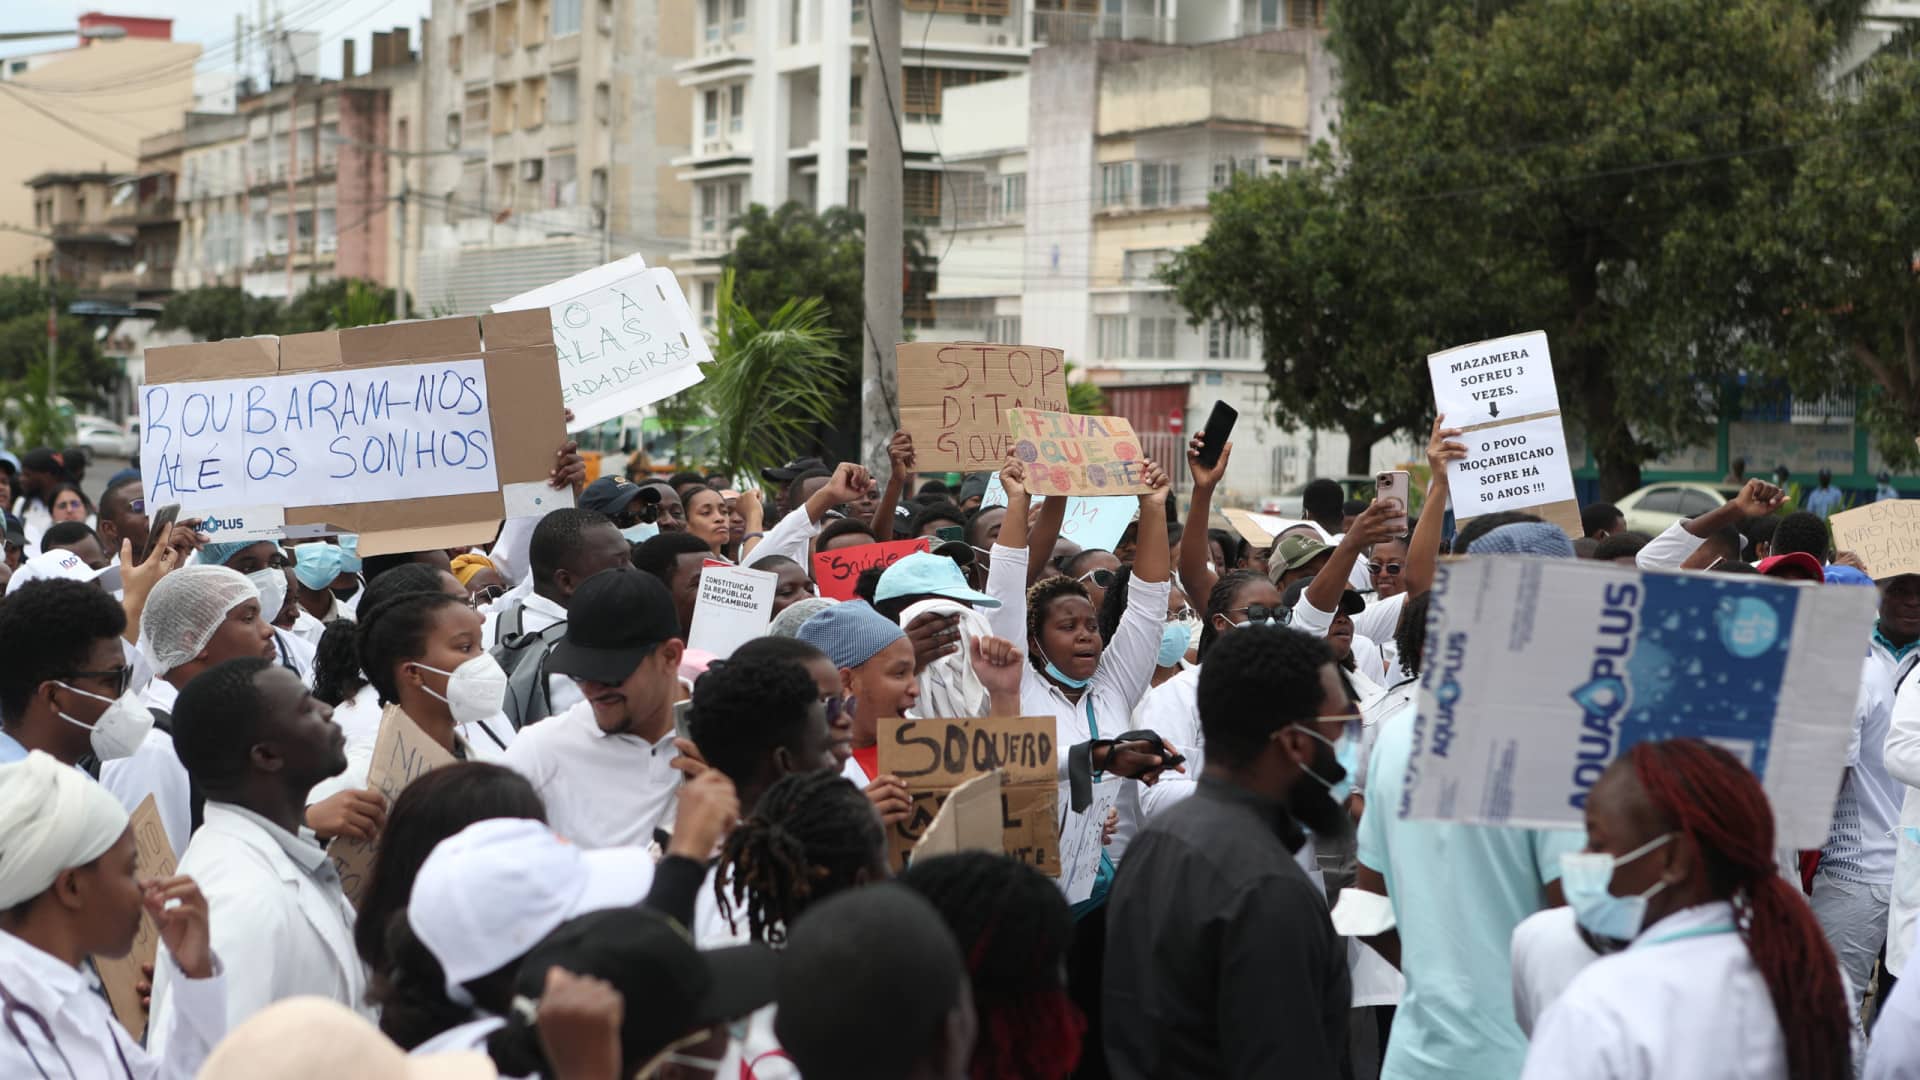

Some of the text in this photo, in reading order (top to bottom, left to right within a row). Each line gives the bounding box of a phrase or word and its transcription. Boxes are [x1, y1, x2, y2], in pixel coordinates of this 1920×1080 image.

[937, 347, 1060, 396] STOP
[1450, 349, 1529, 374] MAZAMERA
[563, 342, 690, 404] ERDADEIRAS
[1460, 366, 1524, 387] SOFREU 3
[1471, 385, 1519, 401] VEZES.
[1041, 441, 1107, 465] QUE
[1481, 435, 1527, 452] O POVO
[248, 447, 297, 480] OS
[329, 430, 488, 478] SONHOS
[1459, 446, 1554, 472] MOÇAMBICANO
[1480, 465, 1540, 486] SOFRE HÁ
[1480, 482, 1545, 502] 50 ANOS !!!
[702, 592, 711, 600] DE
[703, 584, 712, 592] DA
